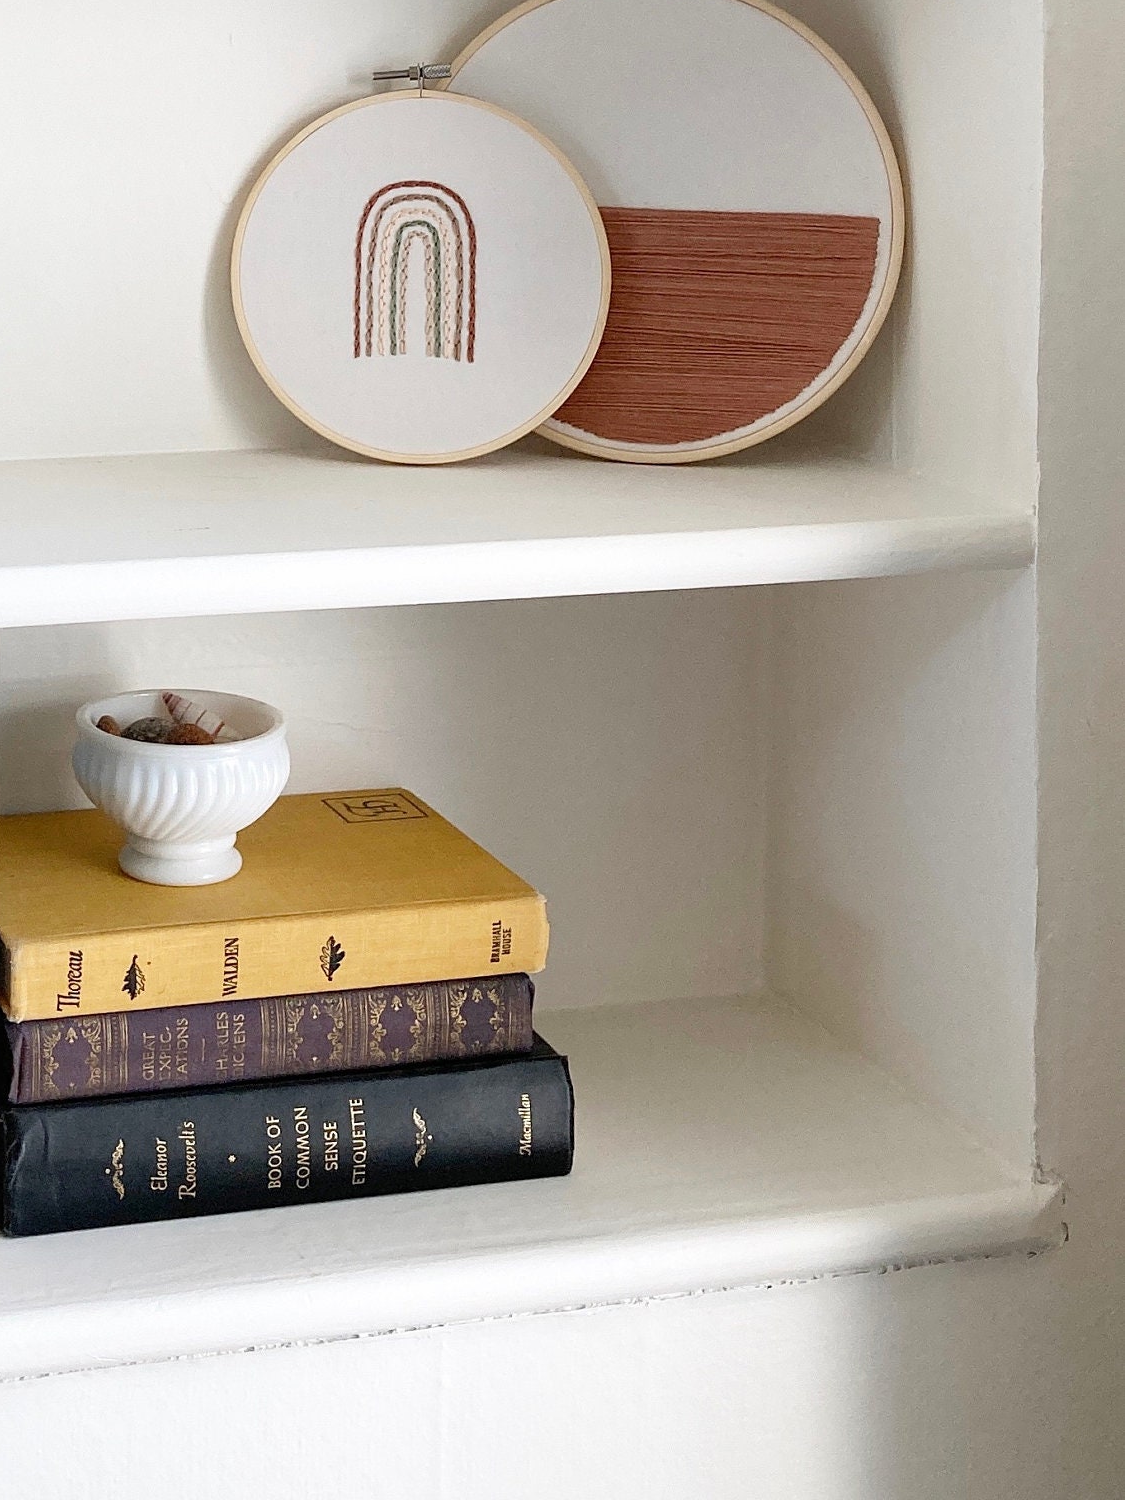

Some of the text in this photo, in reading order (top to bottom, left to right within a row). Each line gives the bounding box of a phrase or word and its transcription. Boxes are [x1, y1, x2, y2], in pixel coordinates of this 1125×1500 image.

[221, 937, 239, 997] WALDEN
[490, 919, 502, 963] BRAMHALL
[501, 926, 512, 956] HOUSE
[56, 949, 84, 1012] Thoreau
[142, 1032, 156, 1081] GREAT
[265, 1115, 282, 1190] BOOK OF
[293, 1106, 311, 1190] COMMON
[323, 1121, 339, 1172] SENSE
[348, 1098, 367, 1186] ETIQUETTE
[517, 1093, 532, 1156] Macmillan
[150, 1137, 168, 1191] Eleanor
